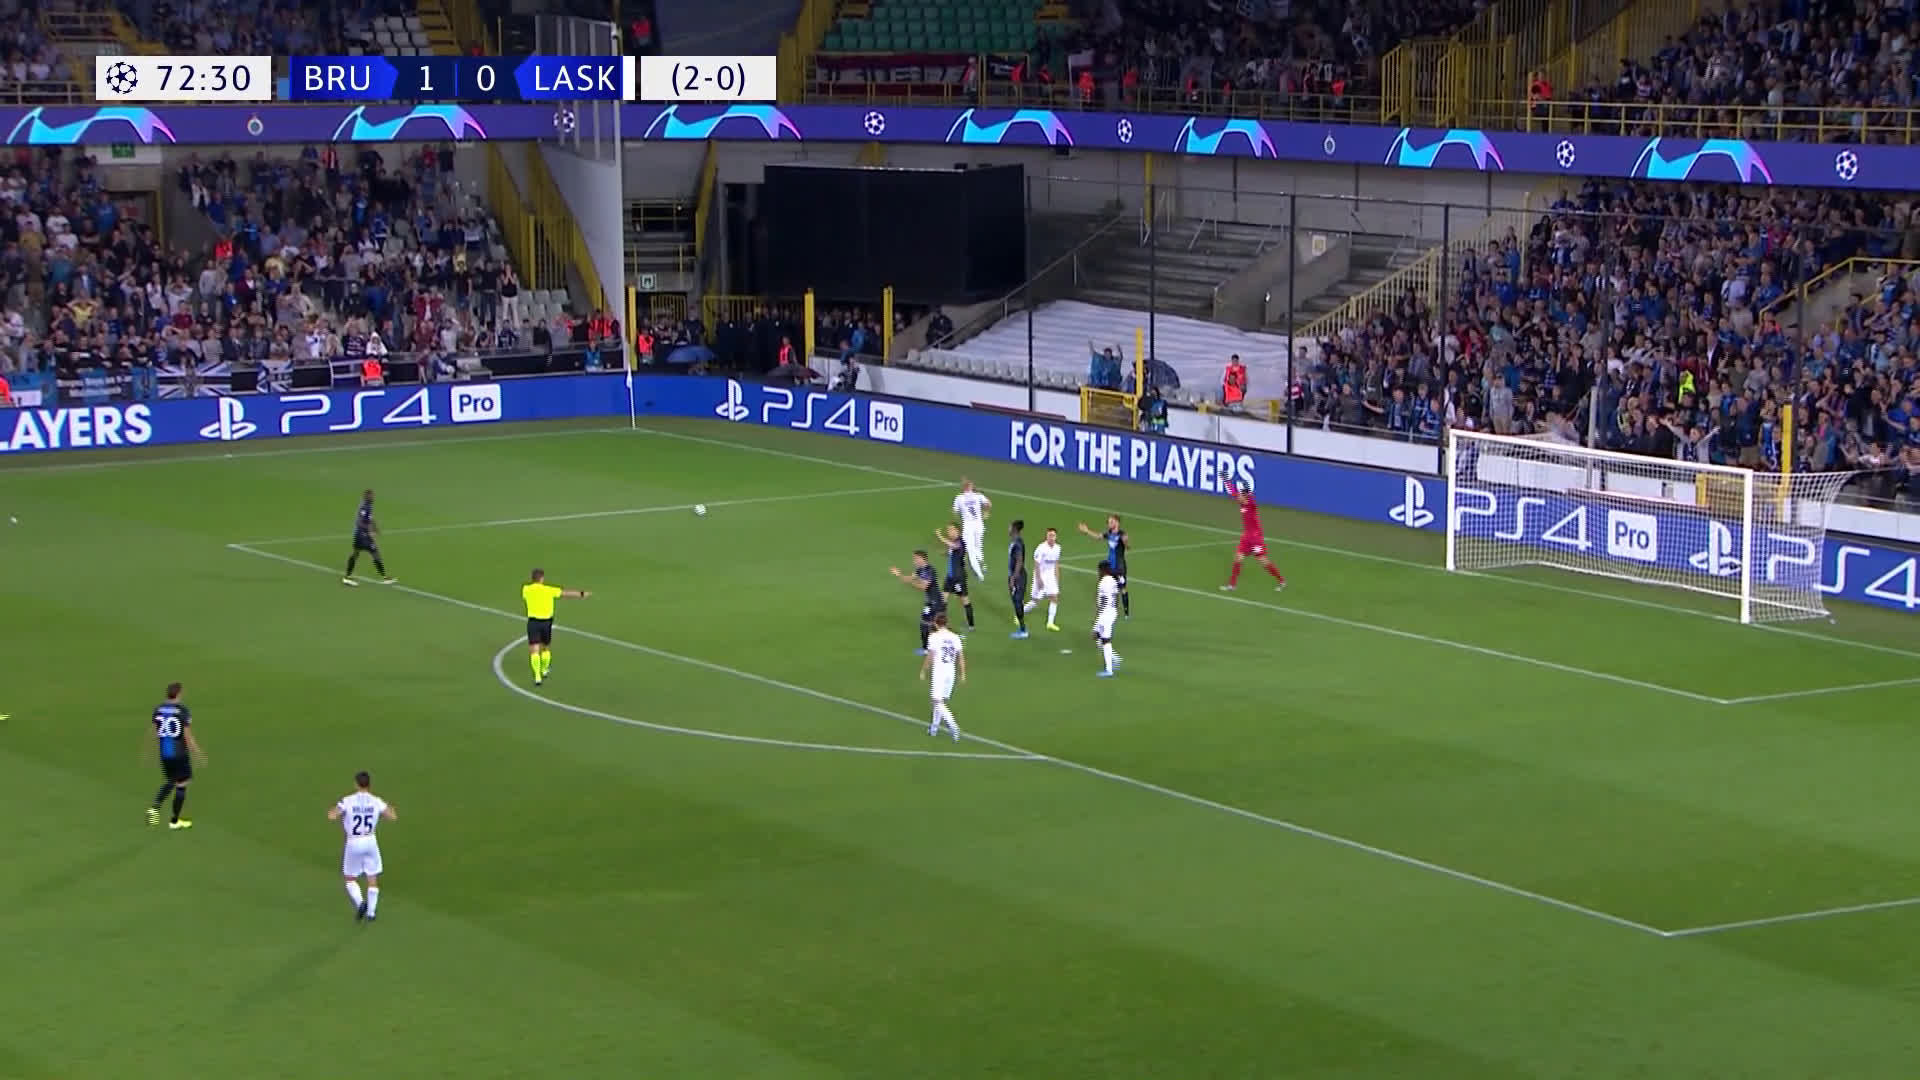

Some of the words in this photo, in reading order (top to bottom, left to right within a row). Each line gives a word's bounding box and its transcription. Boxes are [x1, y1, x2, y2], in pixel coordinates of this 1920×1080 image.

[279, 387, 437, 435] PS4
[458, 391, 495, 415] Pro
[762, 385, 860, 437] PS4
[874, 411, 899, 433] Pro
[1010, 419, 1065, 466] FOR
[1074, 429, 1121, 475] THE
[1130, 439, 1255, 496] PLAYERS
[1454, 488, 1592, 549] PS4
[1614, 522, 1650, 552] Pro
[1767, 532, 1920, 609] PS4
[154, 716, 182, 738] 20
[351, 814, 374, 836] 25
